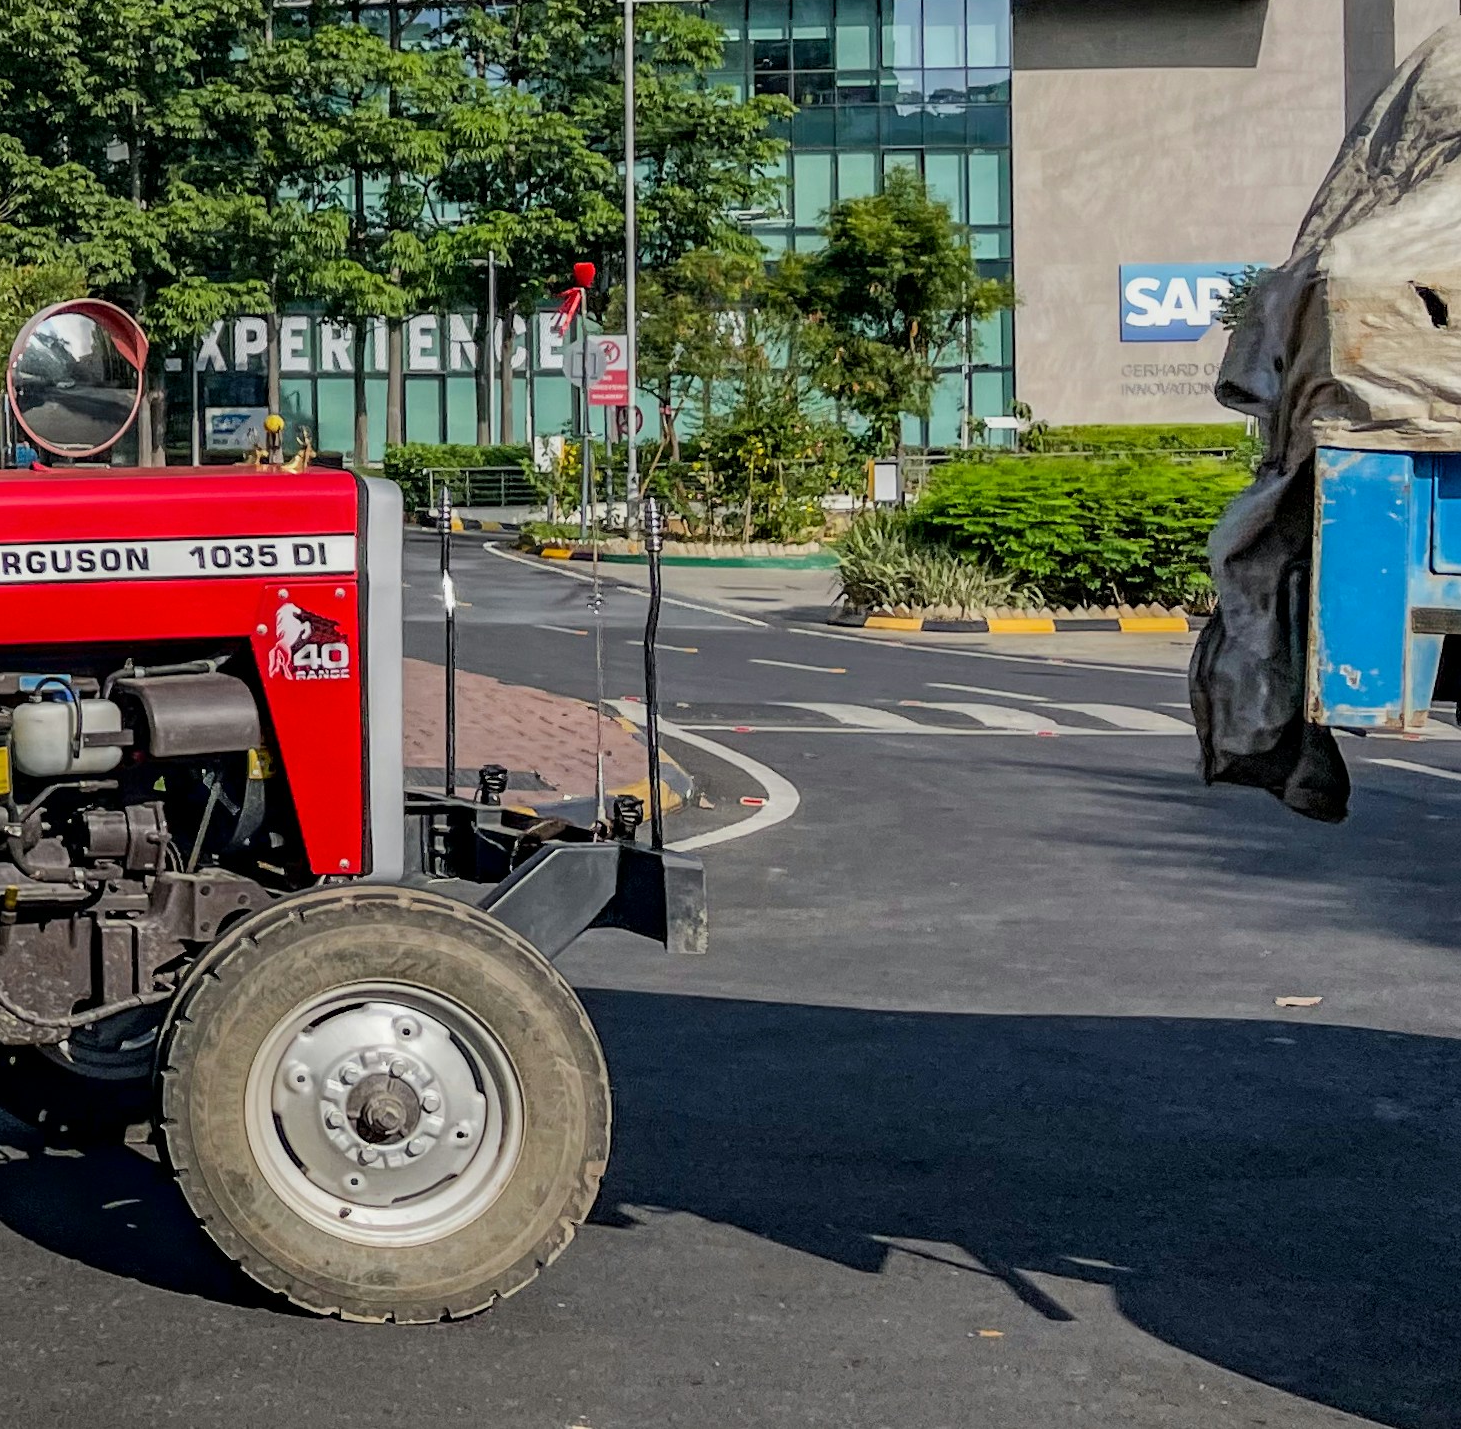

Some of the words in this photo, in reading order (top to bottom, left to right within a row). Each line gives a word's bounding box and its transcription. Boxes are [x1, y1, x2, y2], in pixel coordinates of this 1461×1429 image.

[1125, 277, 1235, 327] SAP
[165, 311, 568, 371] XPERIENCE
[1121, 363, 1199, 378] GERHARD
[189, 544, 279, 569] 1035
[292, 542, 328, 566] DI
[293, 642, 349, 669] 40
[296, 669, 350, 681] RANGE
